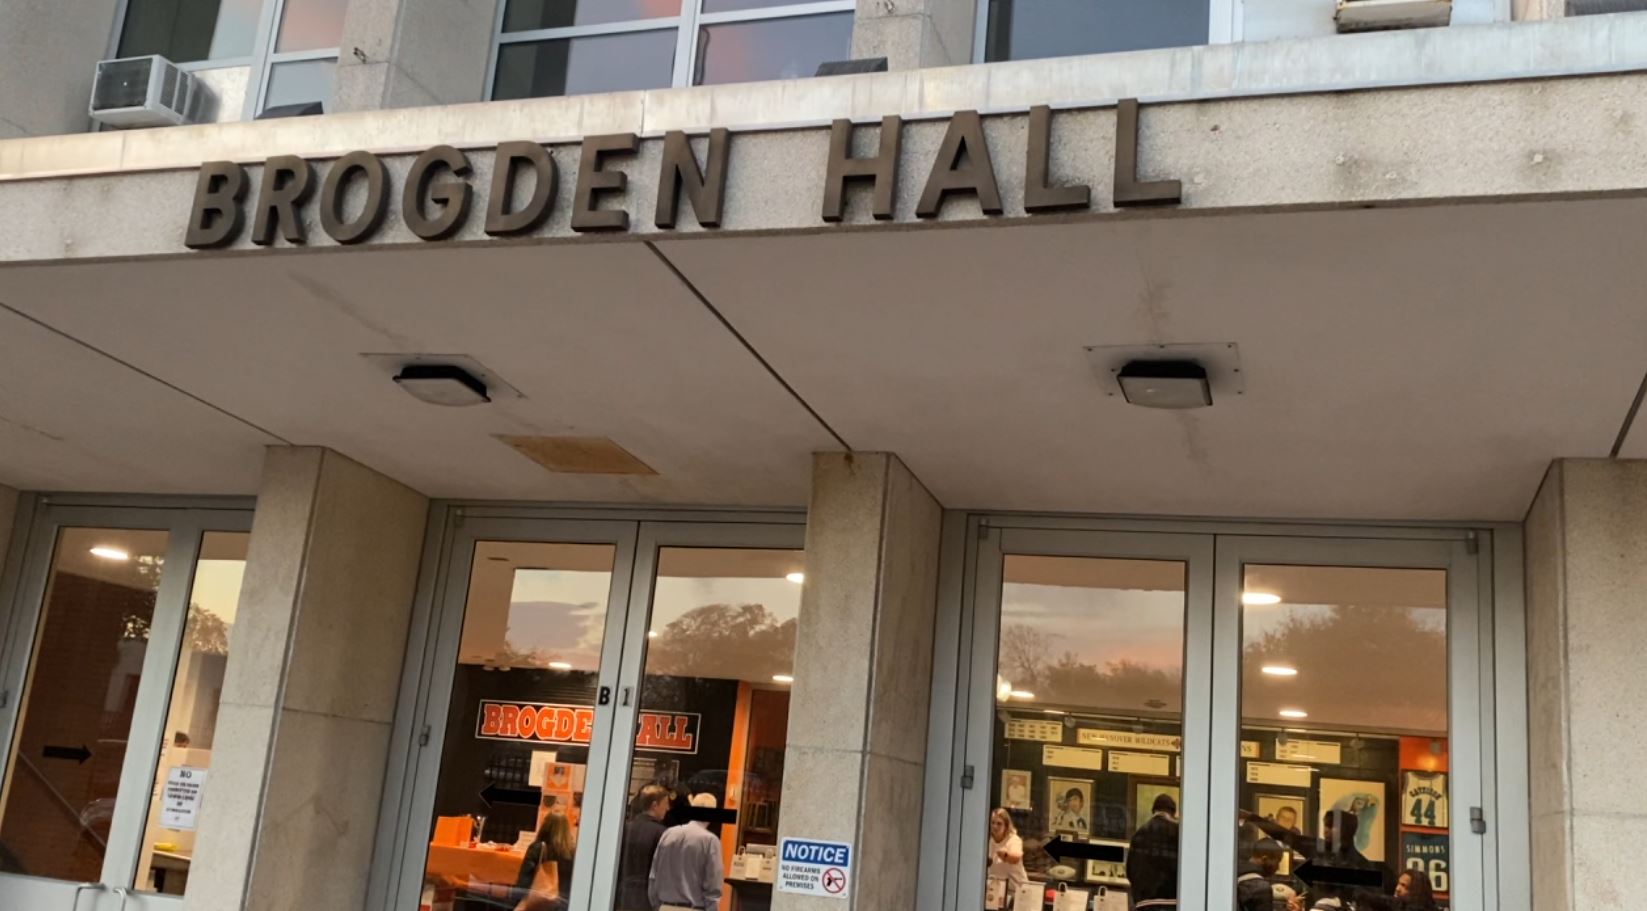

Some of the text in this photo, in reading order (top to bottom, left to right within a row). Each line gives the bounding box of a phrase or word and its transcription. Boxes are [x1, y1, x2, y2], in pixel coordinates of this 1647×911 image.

[184, 98, 1182, 251] BROGDEN HALL
[598, 688, 630, 706] B 1
[481, 703, 693, 750] BROGDE ALL
[180, 770, 192, 779] NO
[1410, 798, 1436, 826] 44
[784, 843, 847, 864] NOTICE
[1406, 844, 1446, 854] SIMMONS
[781, 864, 790, 872] NO
[791, 865, 821, 874] FIREARMS
[782, 873, 810, 881] ALLOWED
[785, 881, 815, 890] PREMISES
